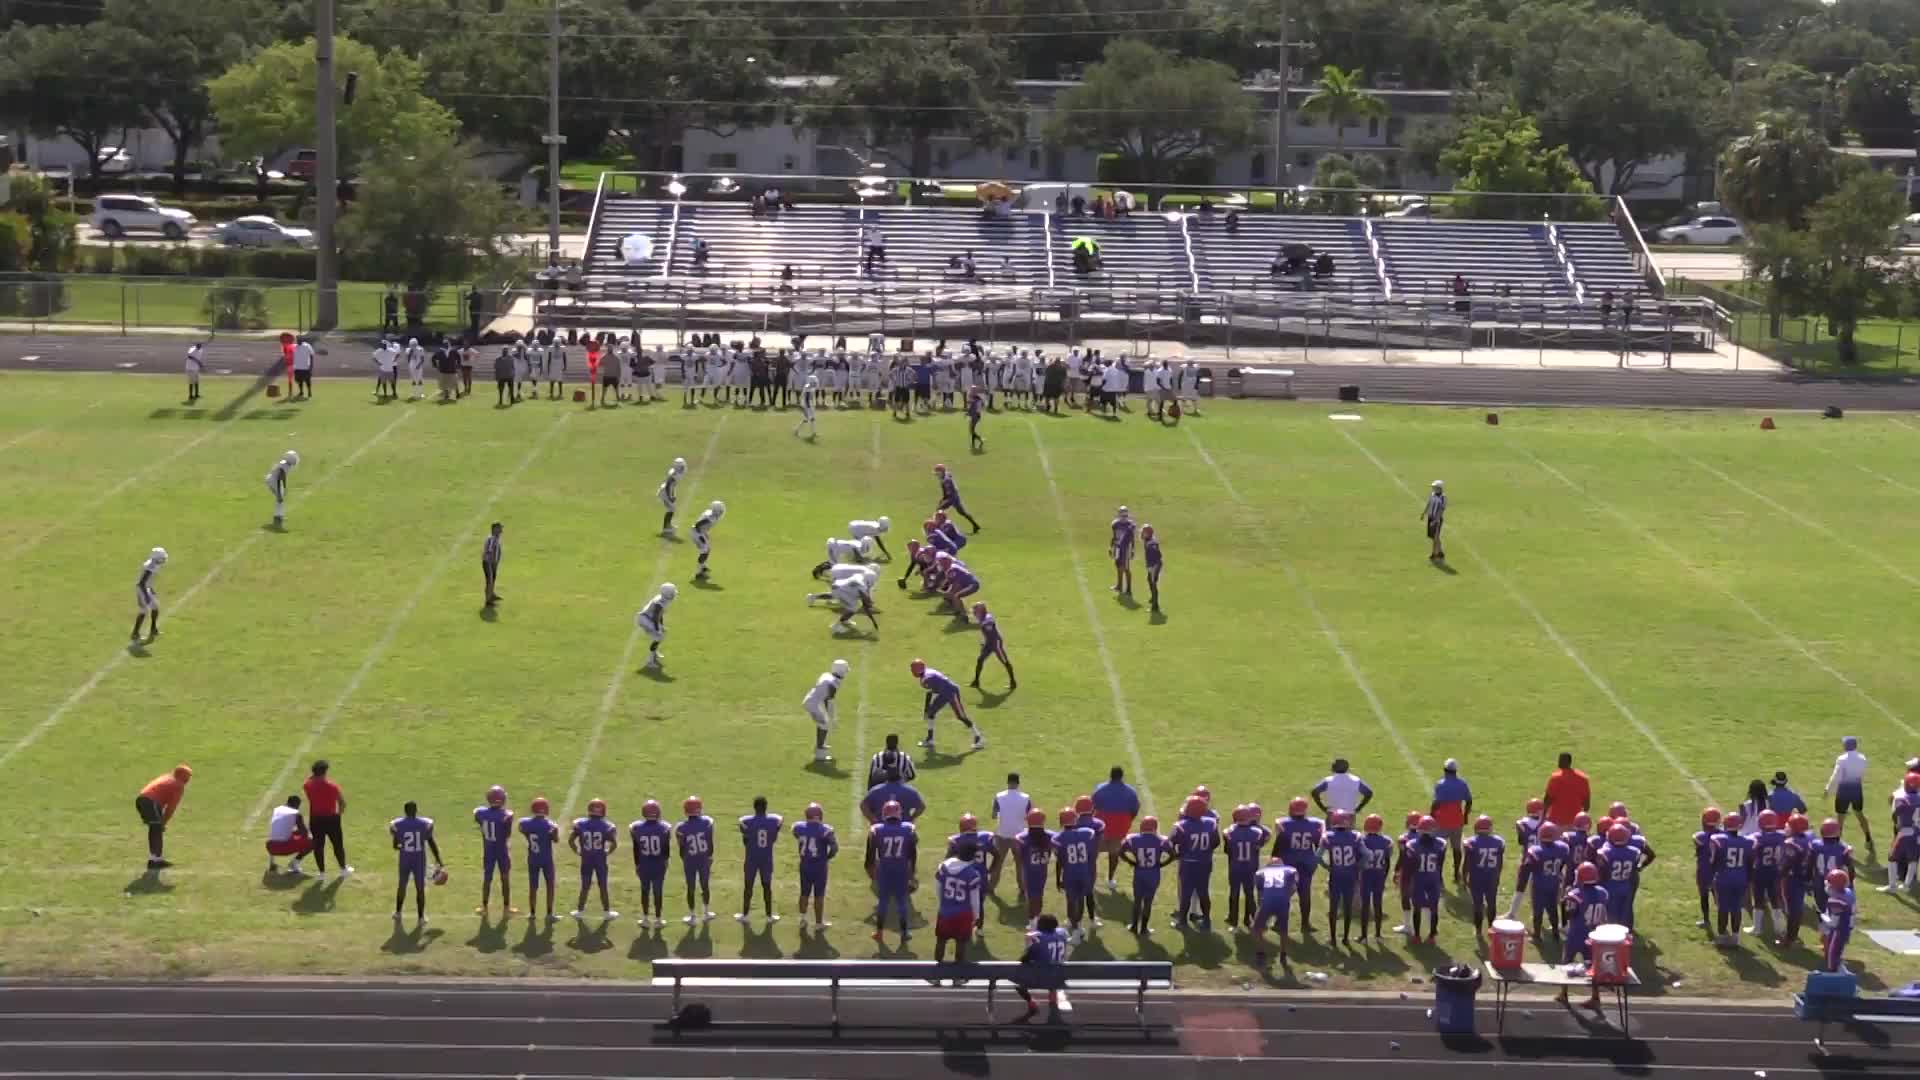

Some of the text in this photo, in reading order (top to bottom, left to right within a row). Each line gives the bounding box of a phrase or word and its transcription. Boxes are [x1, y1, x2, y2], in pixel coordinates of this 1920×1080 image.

[404, 832, 421, 852] 21
[583, 831, 603, 850] 32
[640, 835, 661, 856] 30
[687, 832, 708, 856] 36
[757, 829, 767, 848] 8
[883, 836, 905, 857] 77
[1190, 833, 1210, 850] 70
[1067, 842, 1088, 864] 83
[1237, 841, 1250, 861] 11
[1332, 845, 1355, 867] 82
[1478, 847, 1498, 868] 75
[1726, 848, 1744, 868] 51
[1418, 853, 1437, 872] 16
[1611, 861, 1633, 881] 22
[944, 877, 967, 901] 55
[1601, 951, 1616, 962] G
